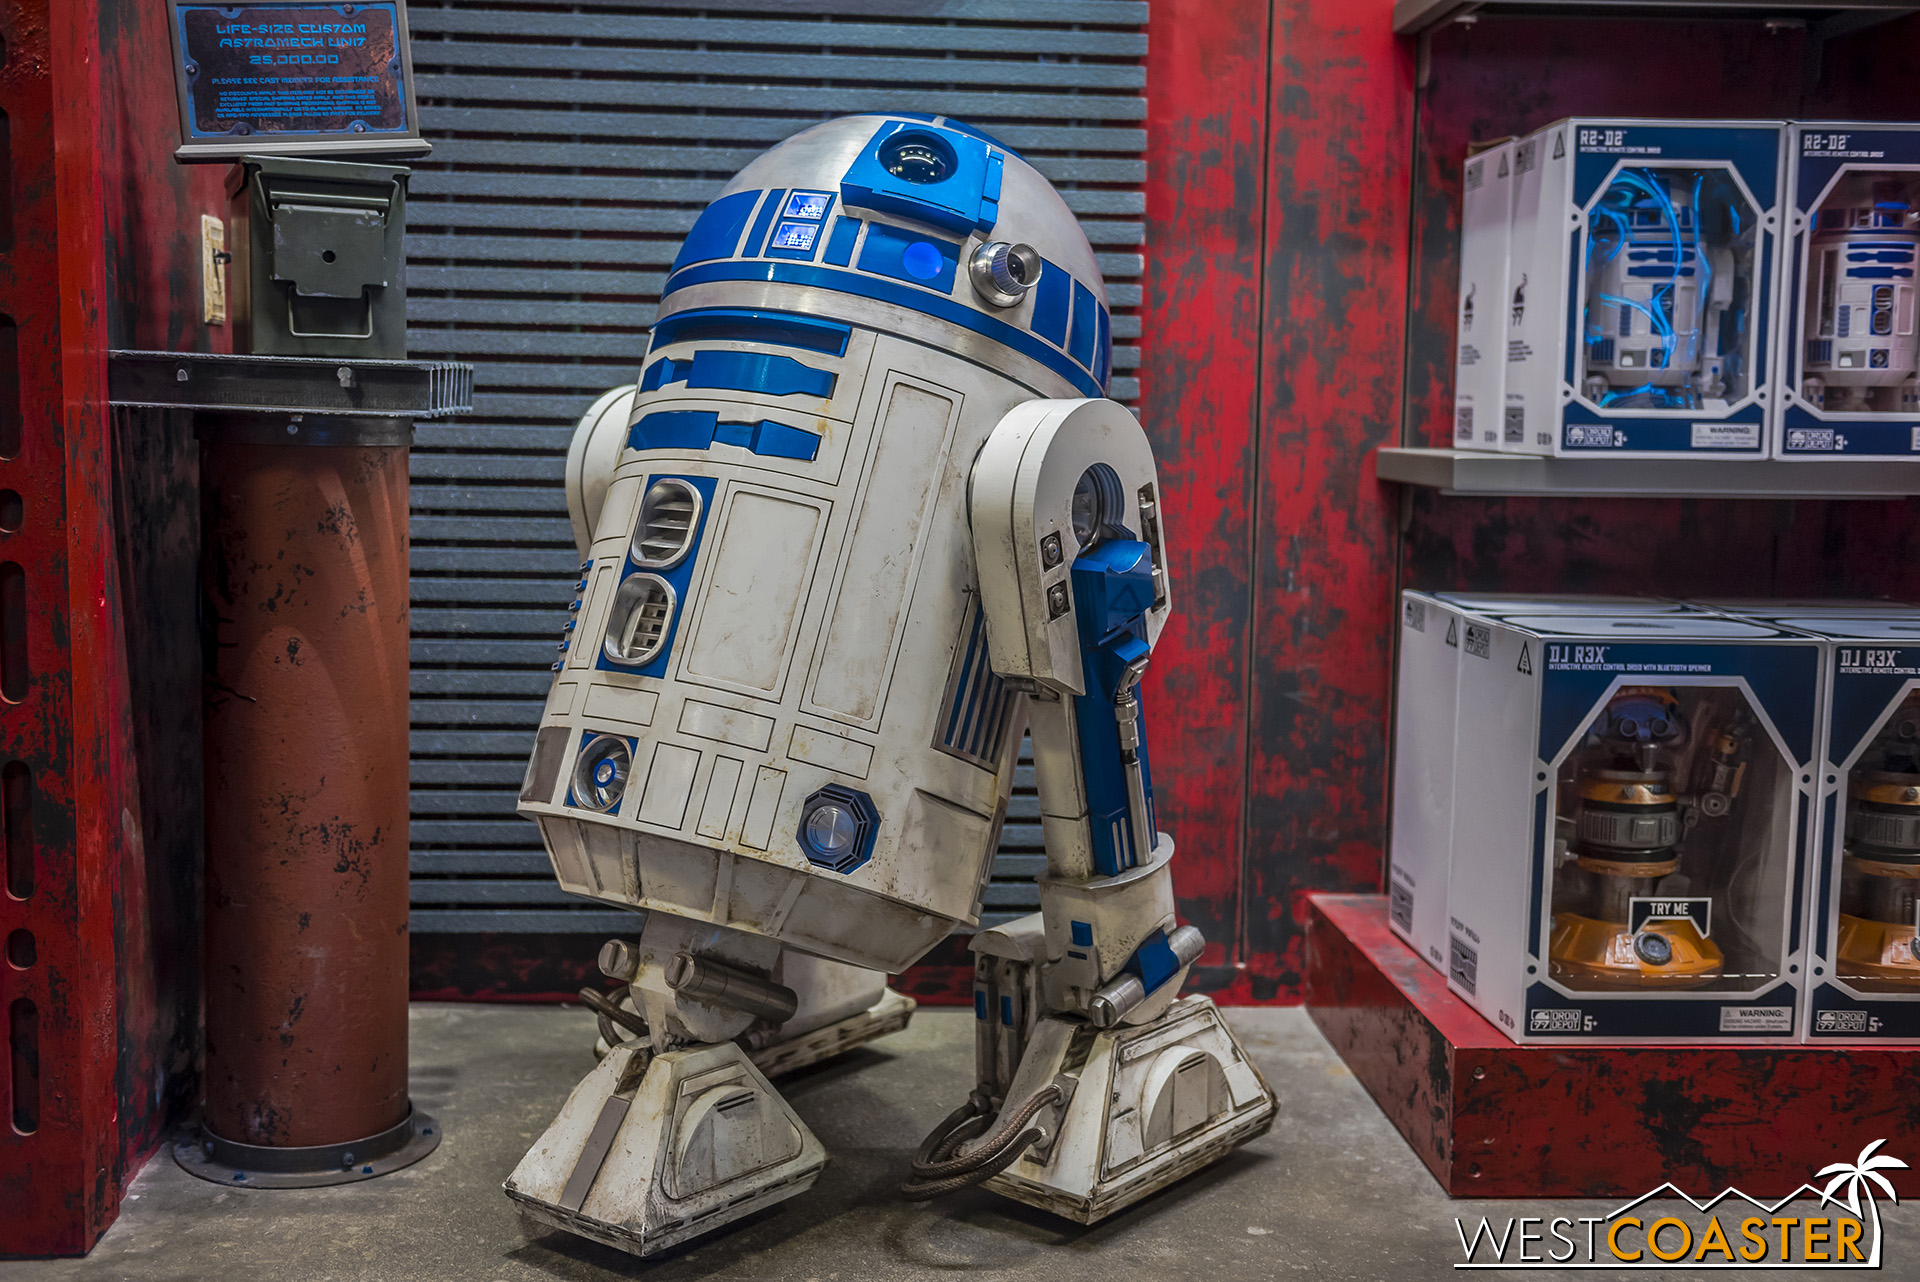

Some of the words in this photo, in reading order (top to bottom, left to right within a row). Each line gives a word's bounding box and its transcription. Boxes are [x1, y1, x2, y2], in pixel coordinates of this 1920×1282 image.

[216, 24, 294, 34] LIFE-SIZE
[298, 24, 366, 34] CUSTOM
[219, 38, 324, 48] ASTROMECH
[328, 38, 366, 47] UNIT
[250, 54, 339, 66] 25,000.00
[1580, 130, 1623, 146] R2-D2
[1804, 134, 1846, 150] R2-D2
[1549, 646, 1569, 663] DJ
[1574, 646, 1605, 663] R3X
[1841, 650, 1860, 666] DJ
[1866, 650, 1896, 667] R3X
[1650, 902, 1671, 915] TRY
[1674, 902, 1689, 915] ME
[1552, 1012, 1579, 1020] DROID
[1838, 1013, 1866, 1021] DROID
[1552, 1020, 1578, 1029] DEPOT
[1837, 1022, 1866, 1030] DEPOT
